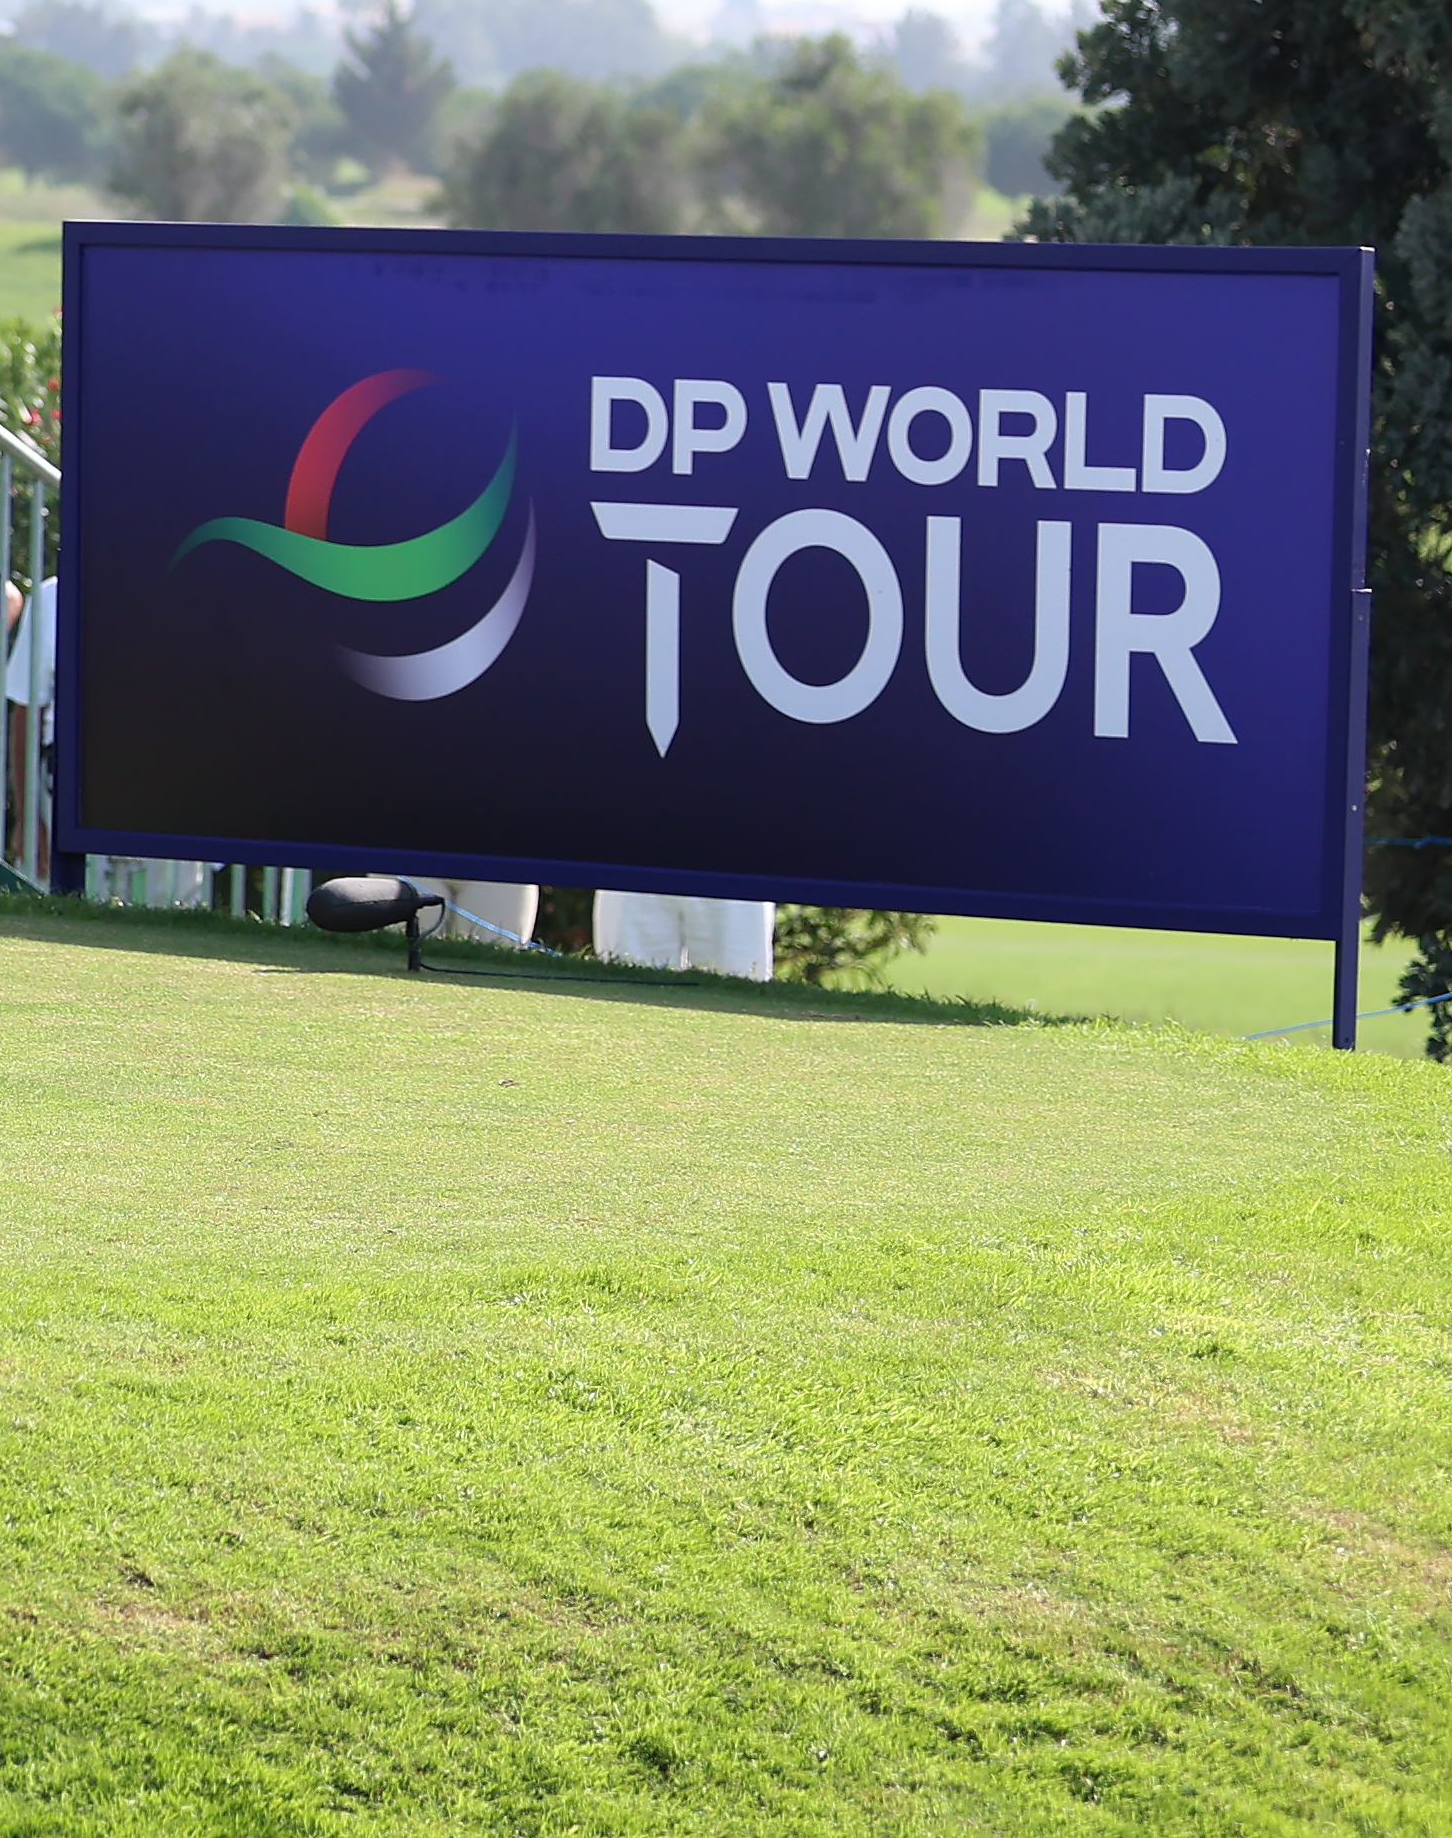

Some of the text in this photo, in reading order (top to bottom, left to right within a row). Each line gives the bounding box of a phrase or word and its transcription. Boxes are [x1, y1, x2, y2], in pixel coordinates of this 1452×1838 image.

[591, 376, 1227, 494] DP WORLD
[590, 501, 1238, 759] TOUR
